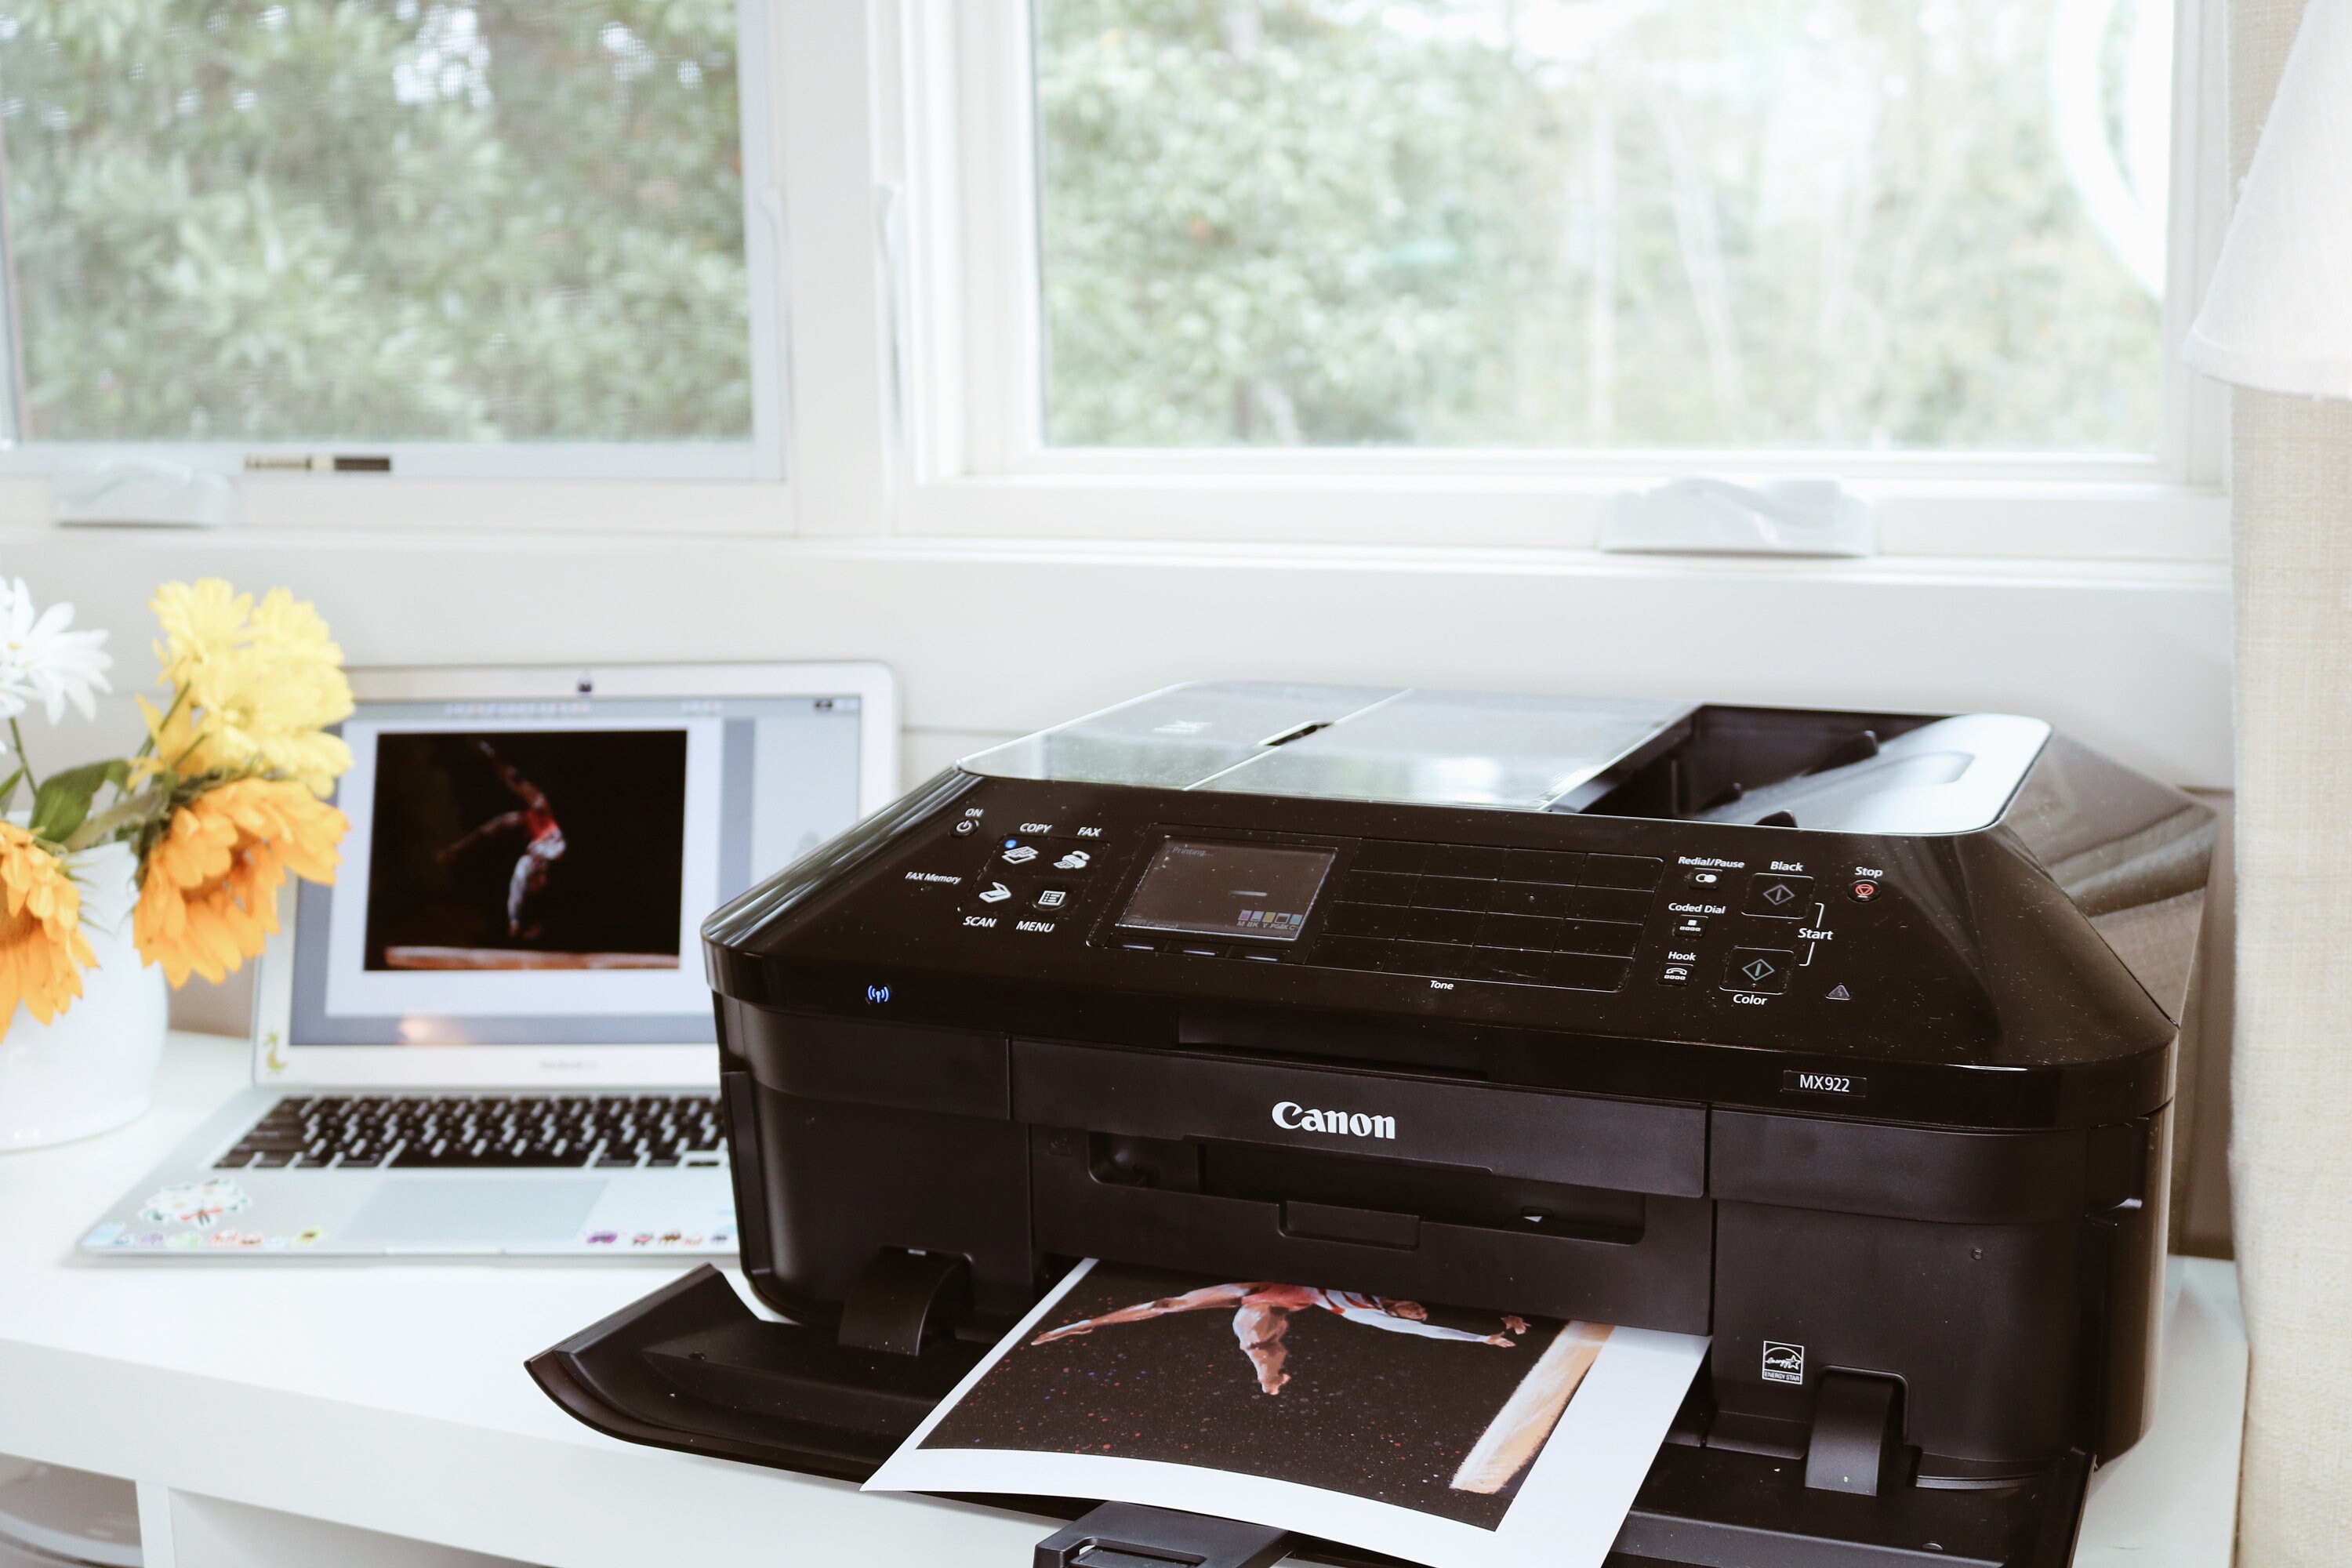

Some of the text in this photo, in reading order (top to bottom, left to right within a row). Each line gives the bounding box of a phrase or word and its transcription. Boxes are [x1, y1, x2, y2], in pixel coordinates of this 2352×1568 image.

[964, 808, 983, 818] ON
[1019, 822, 1052, 834] COPY
[1076, 826, 1102, 837] FAX
[1678, 855, 1745, 869] Redial/Pause
[1769, 861, 1803, 872] Black
[905, 871, 961, 885] FAX Memory
[1855, 866, 1883, 879] Stop
[1668, 902, 1726, 914] Coded Dial
[963, 916, 997, 928] SCAN
[1015, 920, 1055, 933] MENU
[1798, 927, 1834, 941] Start
[1668, 951, 1697, 961] Hook
[1430, 980, 1454, 990] Tone
[1733, 993, 1768, 1006] Color
[1799, 1074, 1850, 1092] MX922
[1272, 1101, 1396, 1140] Canon
